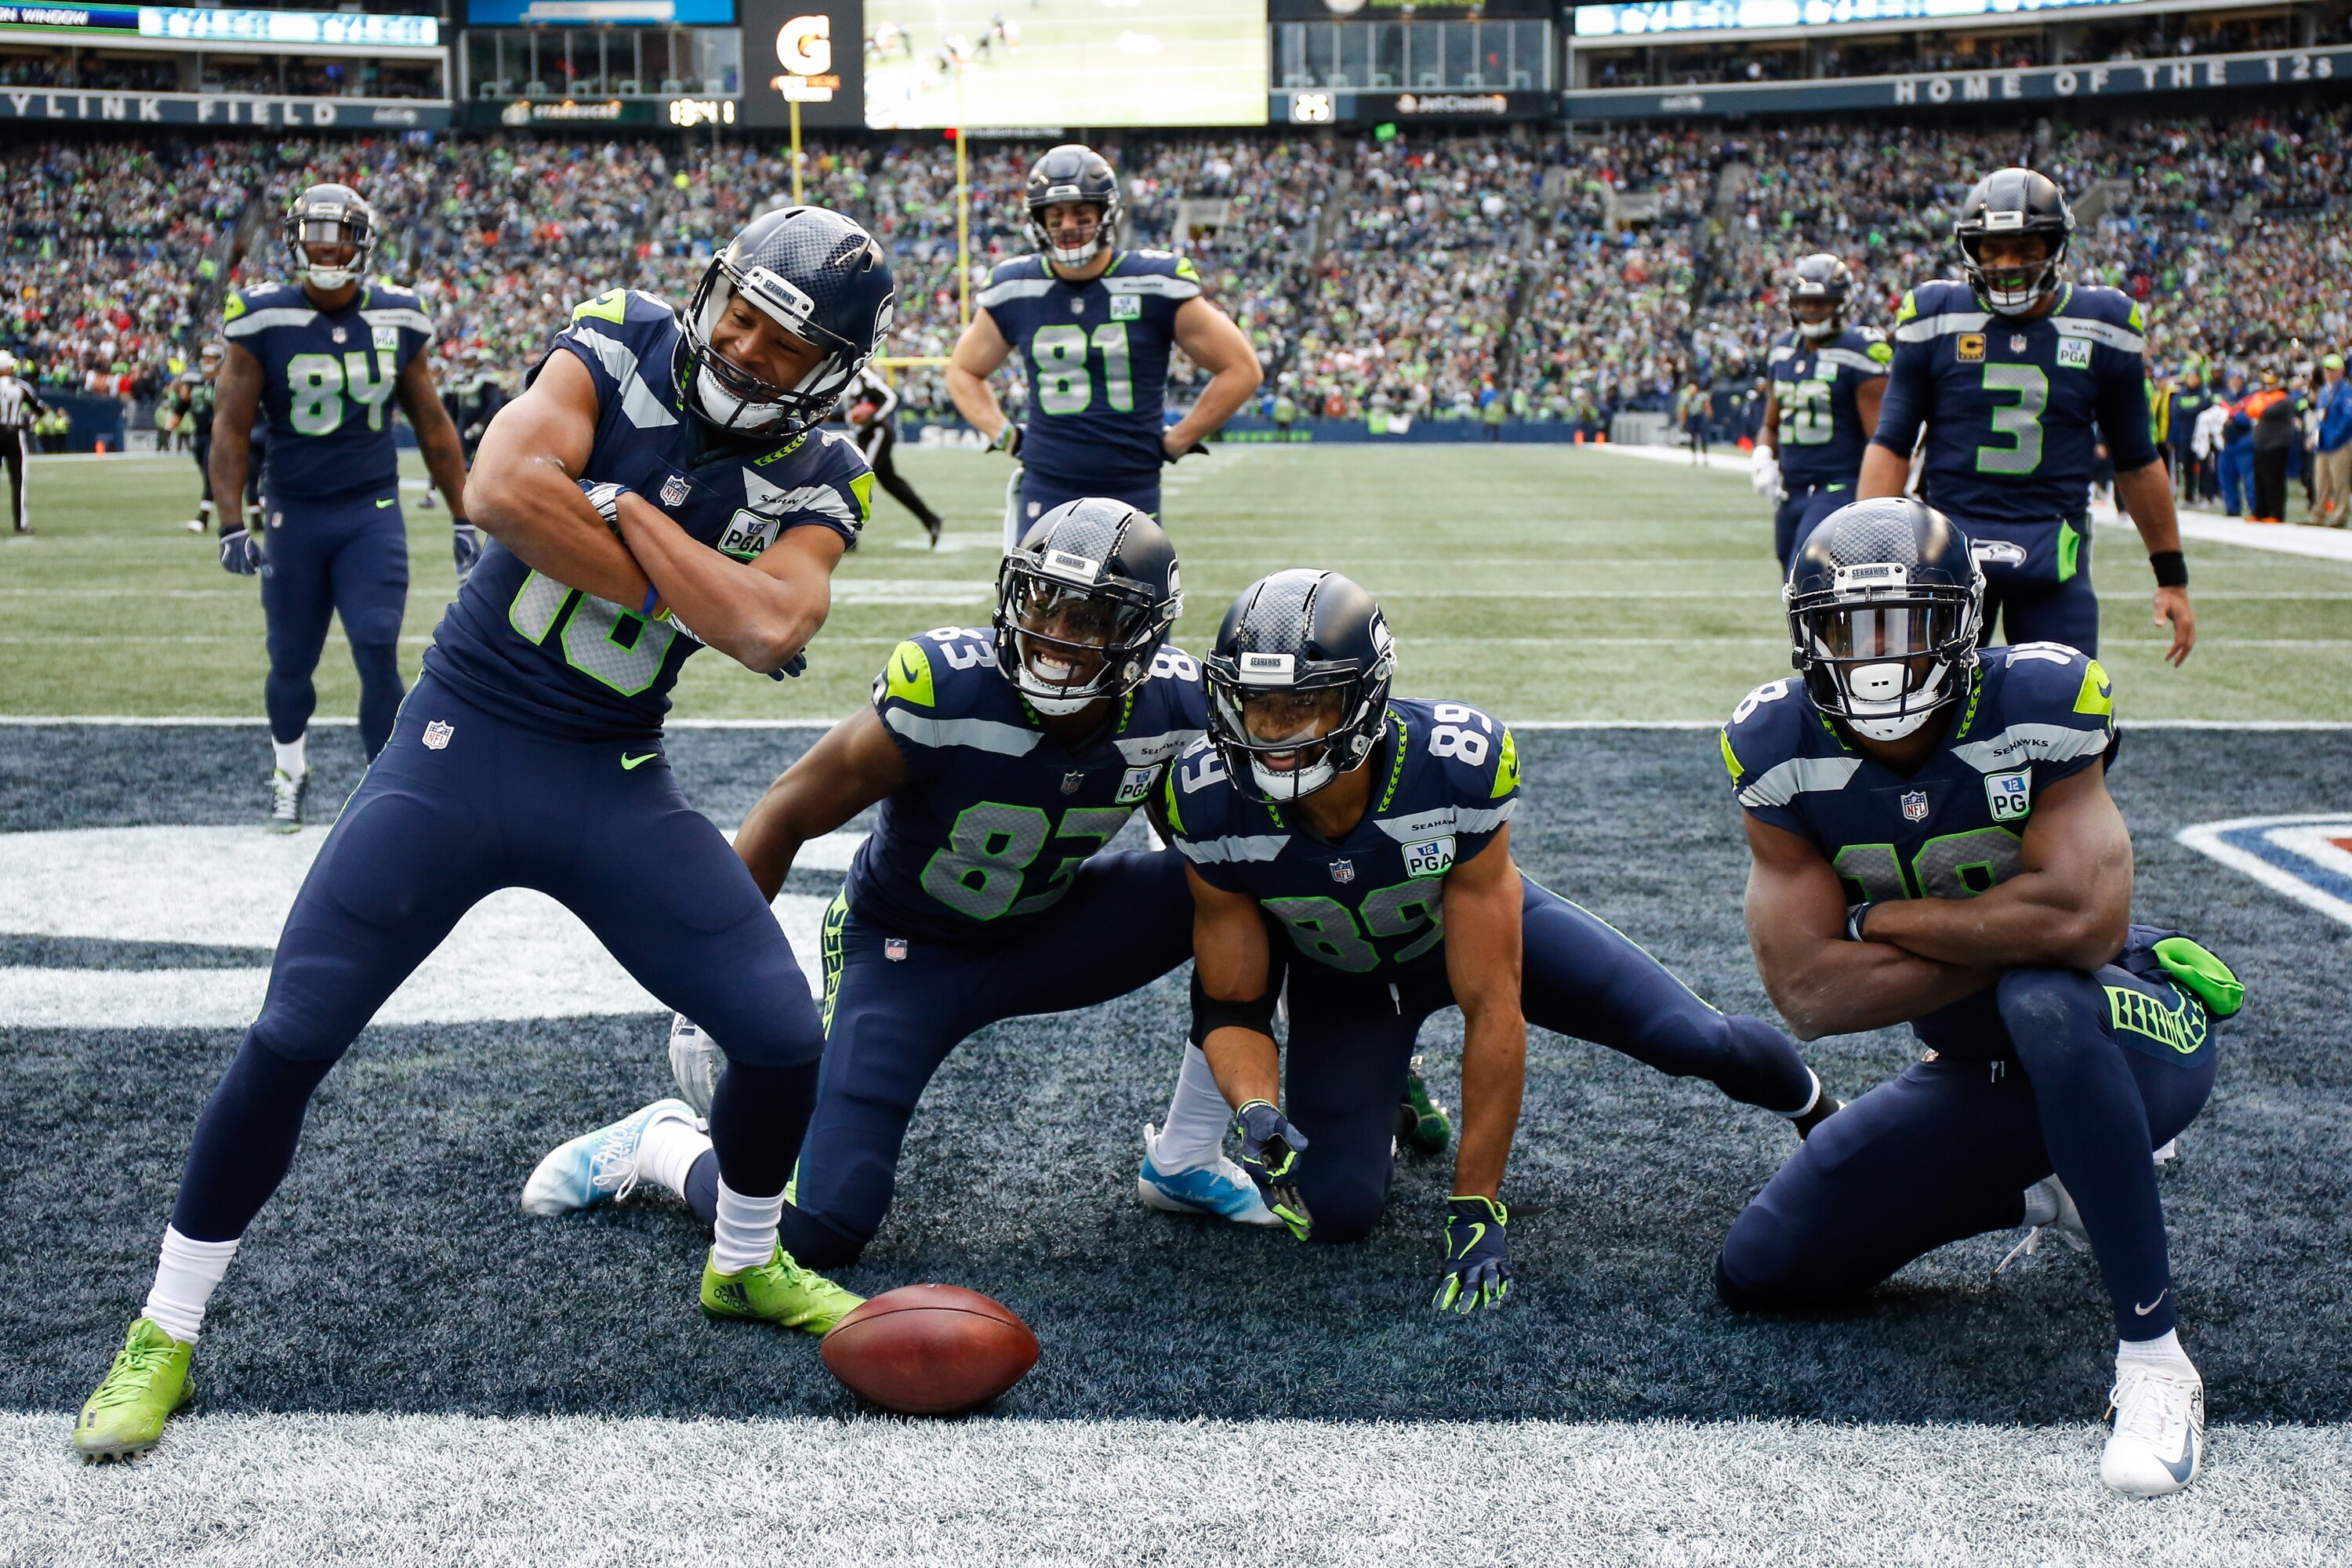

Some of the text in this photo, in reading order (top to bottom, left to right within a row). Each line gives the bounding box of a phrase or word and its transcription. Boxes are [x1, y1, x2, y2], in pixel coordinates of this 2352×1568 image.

[20, 8, 89, 25] WINDOW
[1894, 74, 2022, 105] HOME
[2053, 69, 2109, 96] OF
[2141, 60, 2227, 90] THE
[9, 93, 337, 126] YLINK FIELD
[763, 280, 798, 306] SEAHAWKS
[2060, 350, 2088, 364] PGA
[1033, 321, 1134, 415] 81
[287, 350, 398, 436] 84
[1976, 363, 2049, 474] 3
[663, 488, 681, 503] NFL
[724, 528, 765, 554] PGA
[1852, 567, 1889, 579] SEAHAWKS
[1148, 643, 1200, 683] 8
[1250, 657, 1281, 667] SEAHAWKS
[427, 731, 445, 746] NFL
[1428, 703, 1493, 767] 89
[1121, 782, 1152, 798] PGA
[2008, 779, 2020, 791] 12
[1907, 804, 1926, 816] NFL
[1994, 794, 2027, 815] PG
[1422, 845, 1434, 855] 12
[1410, 852, 1454, 873] PGA
[1334, 870, 1352, 880] NFL
[1261, 876, 1445, 973] 89
